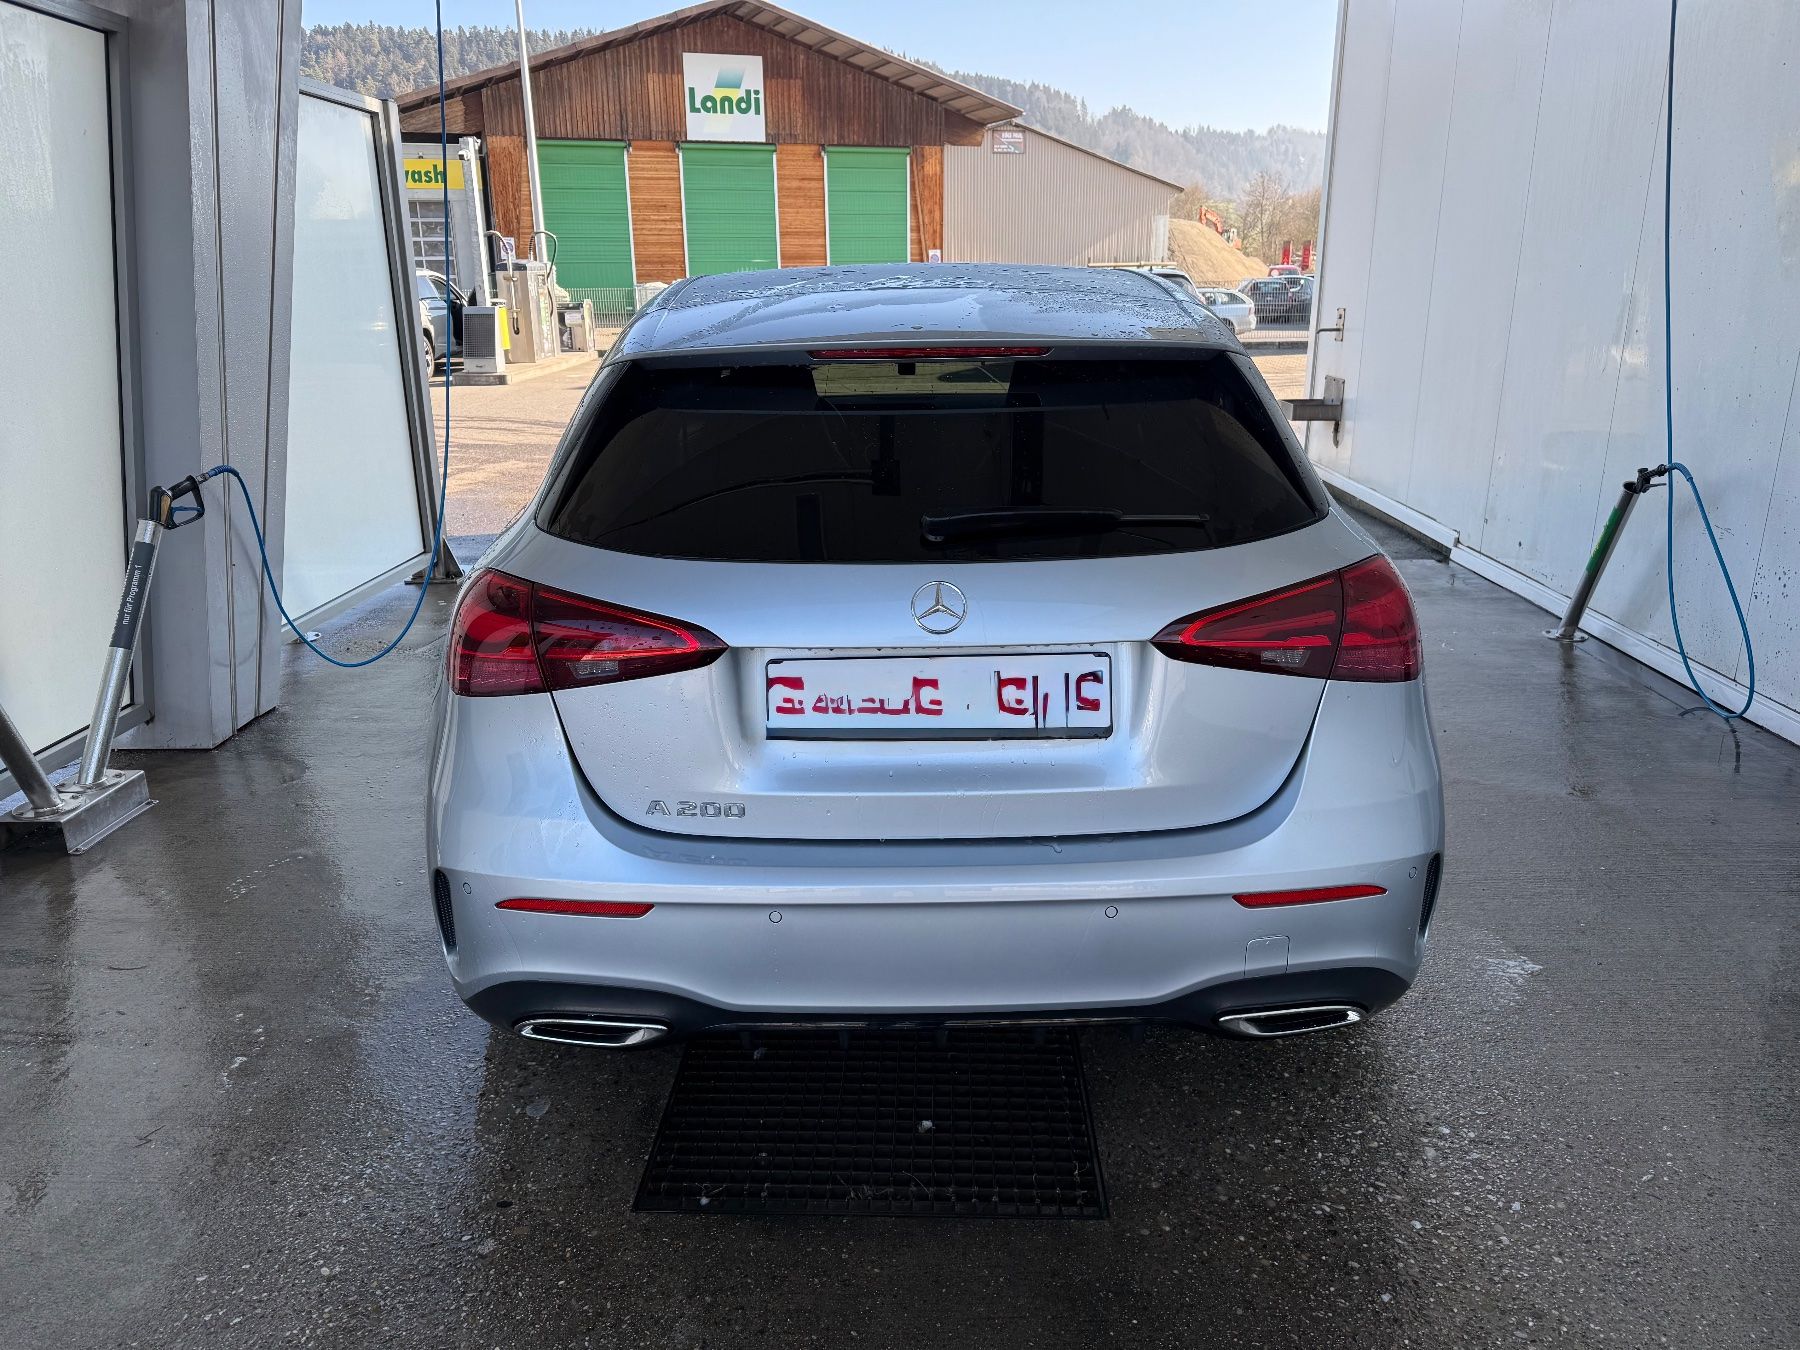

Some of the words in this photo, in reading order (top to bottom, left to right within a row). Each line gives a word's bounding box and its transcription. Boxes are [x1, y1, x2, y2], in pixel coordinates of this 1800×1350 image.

[688, 86, 761, 116] Landi
[127, 569, 141, 602] Programm
[124, 603, 133, 613] für
[123, 614, 131, 625] nur
[645, 800, 671, 816] A
[676, 800, 746, 818] 200
